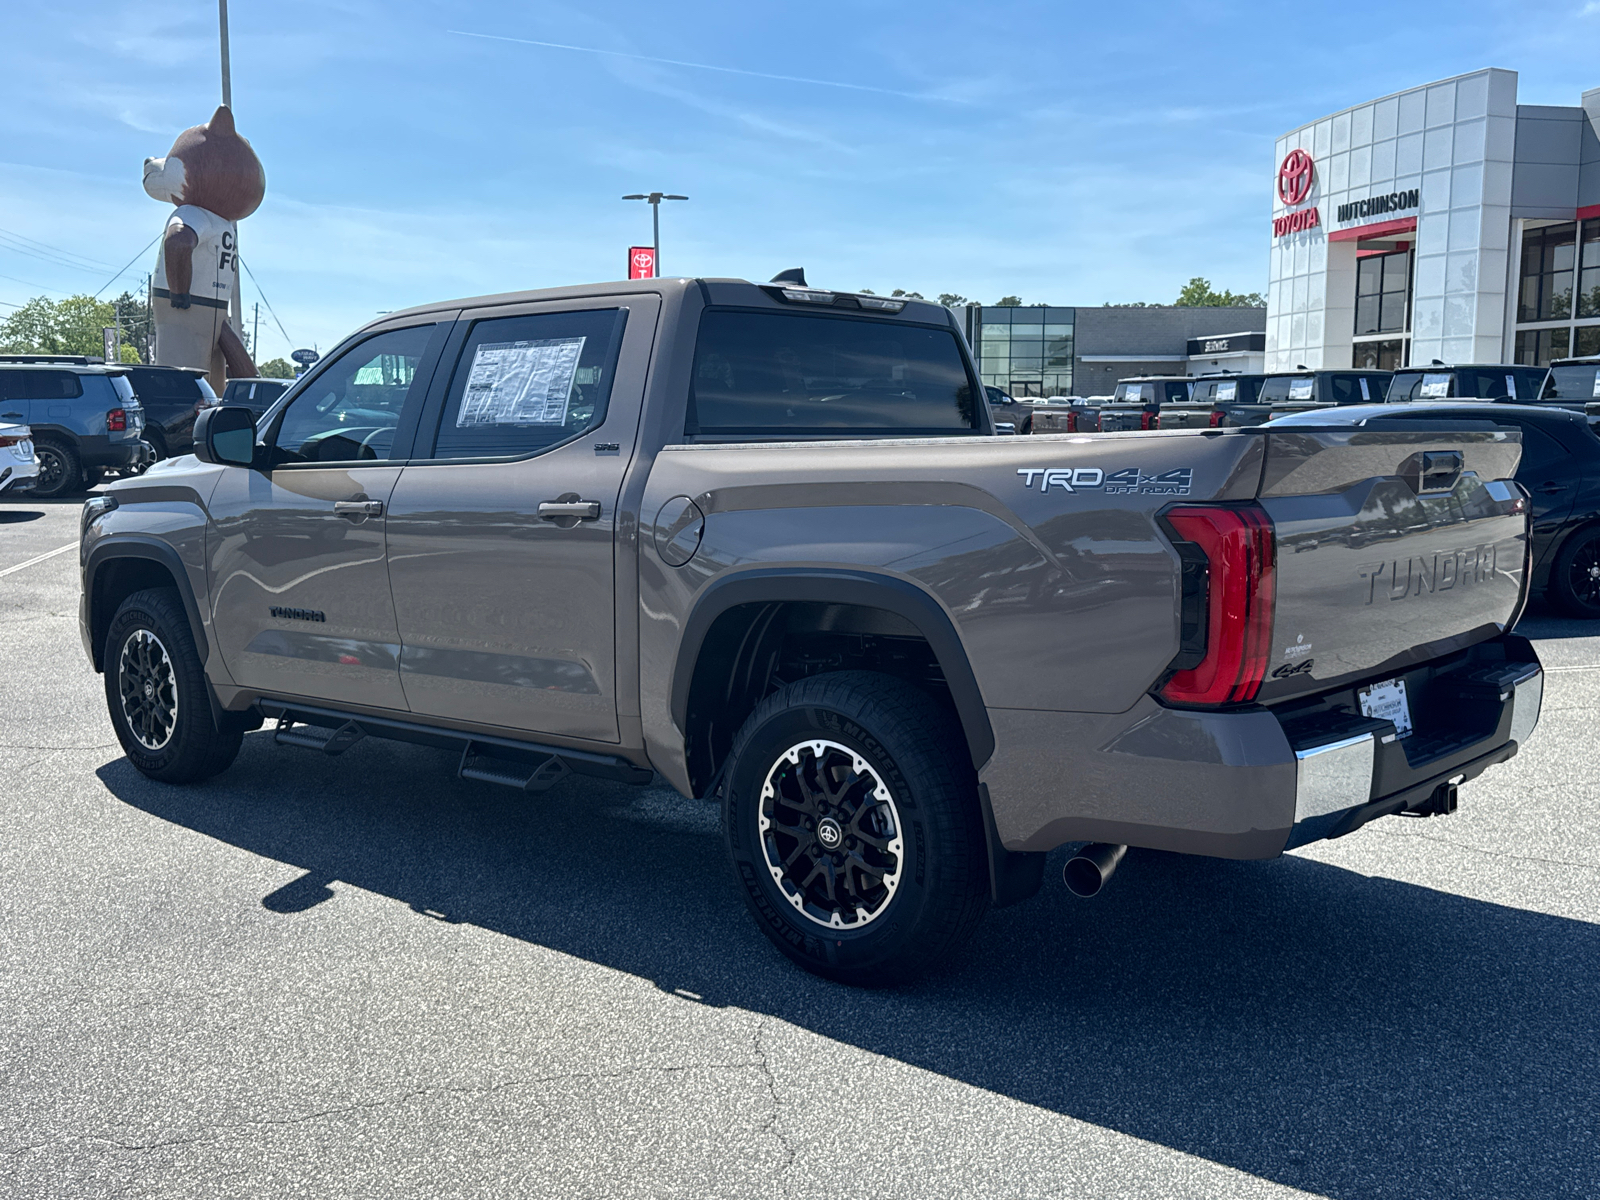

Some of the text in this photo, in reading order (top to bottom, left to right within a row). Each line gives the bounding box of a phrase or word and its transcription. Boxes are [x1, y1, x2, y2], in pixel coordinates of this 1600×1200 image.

[1338, 189, 1419, 222] HUTCHINSON
[1272, 207, 1320, 238] TOYOTA
[1204, 339, 1230, 352] SERVICE
[1017, 467, 1193, 495] TRD 4x4
[1105, 486, 1191, 496] OFF ROAD
[1356, 544, 1497, 606] TUNDRA
[121, 610, 154, 627] MICHELIN
[268, 606, 326, 622] TUNDRA
[1271, 658, 1314, 678] 4x4
[842, 721, 913, 804] MICHELIN
[741, 865, 802, 946] MICHELIN
